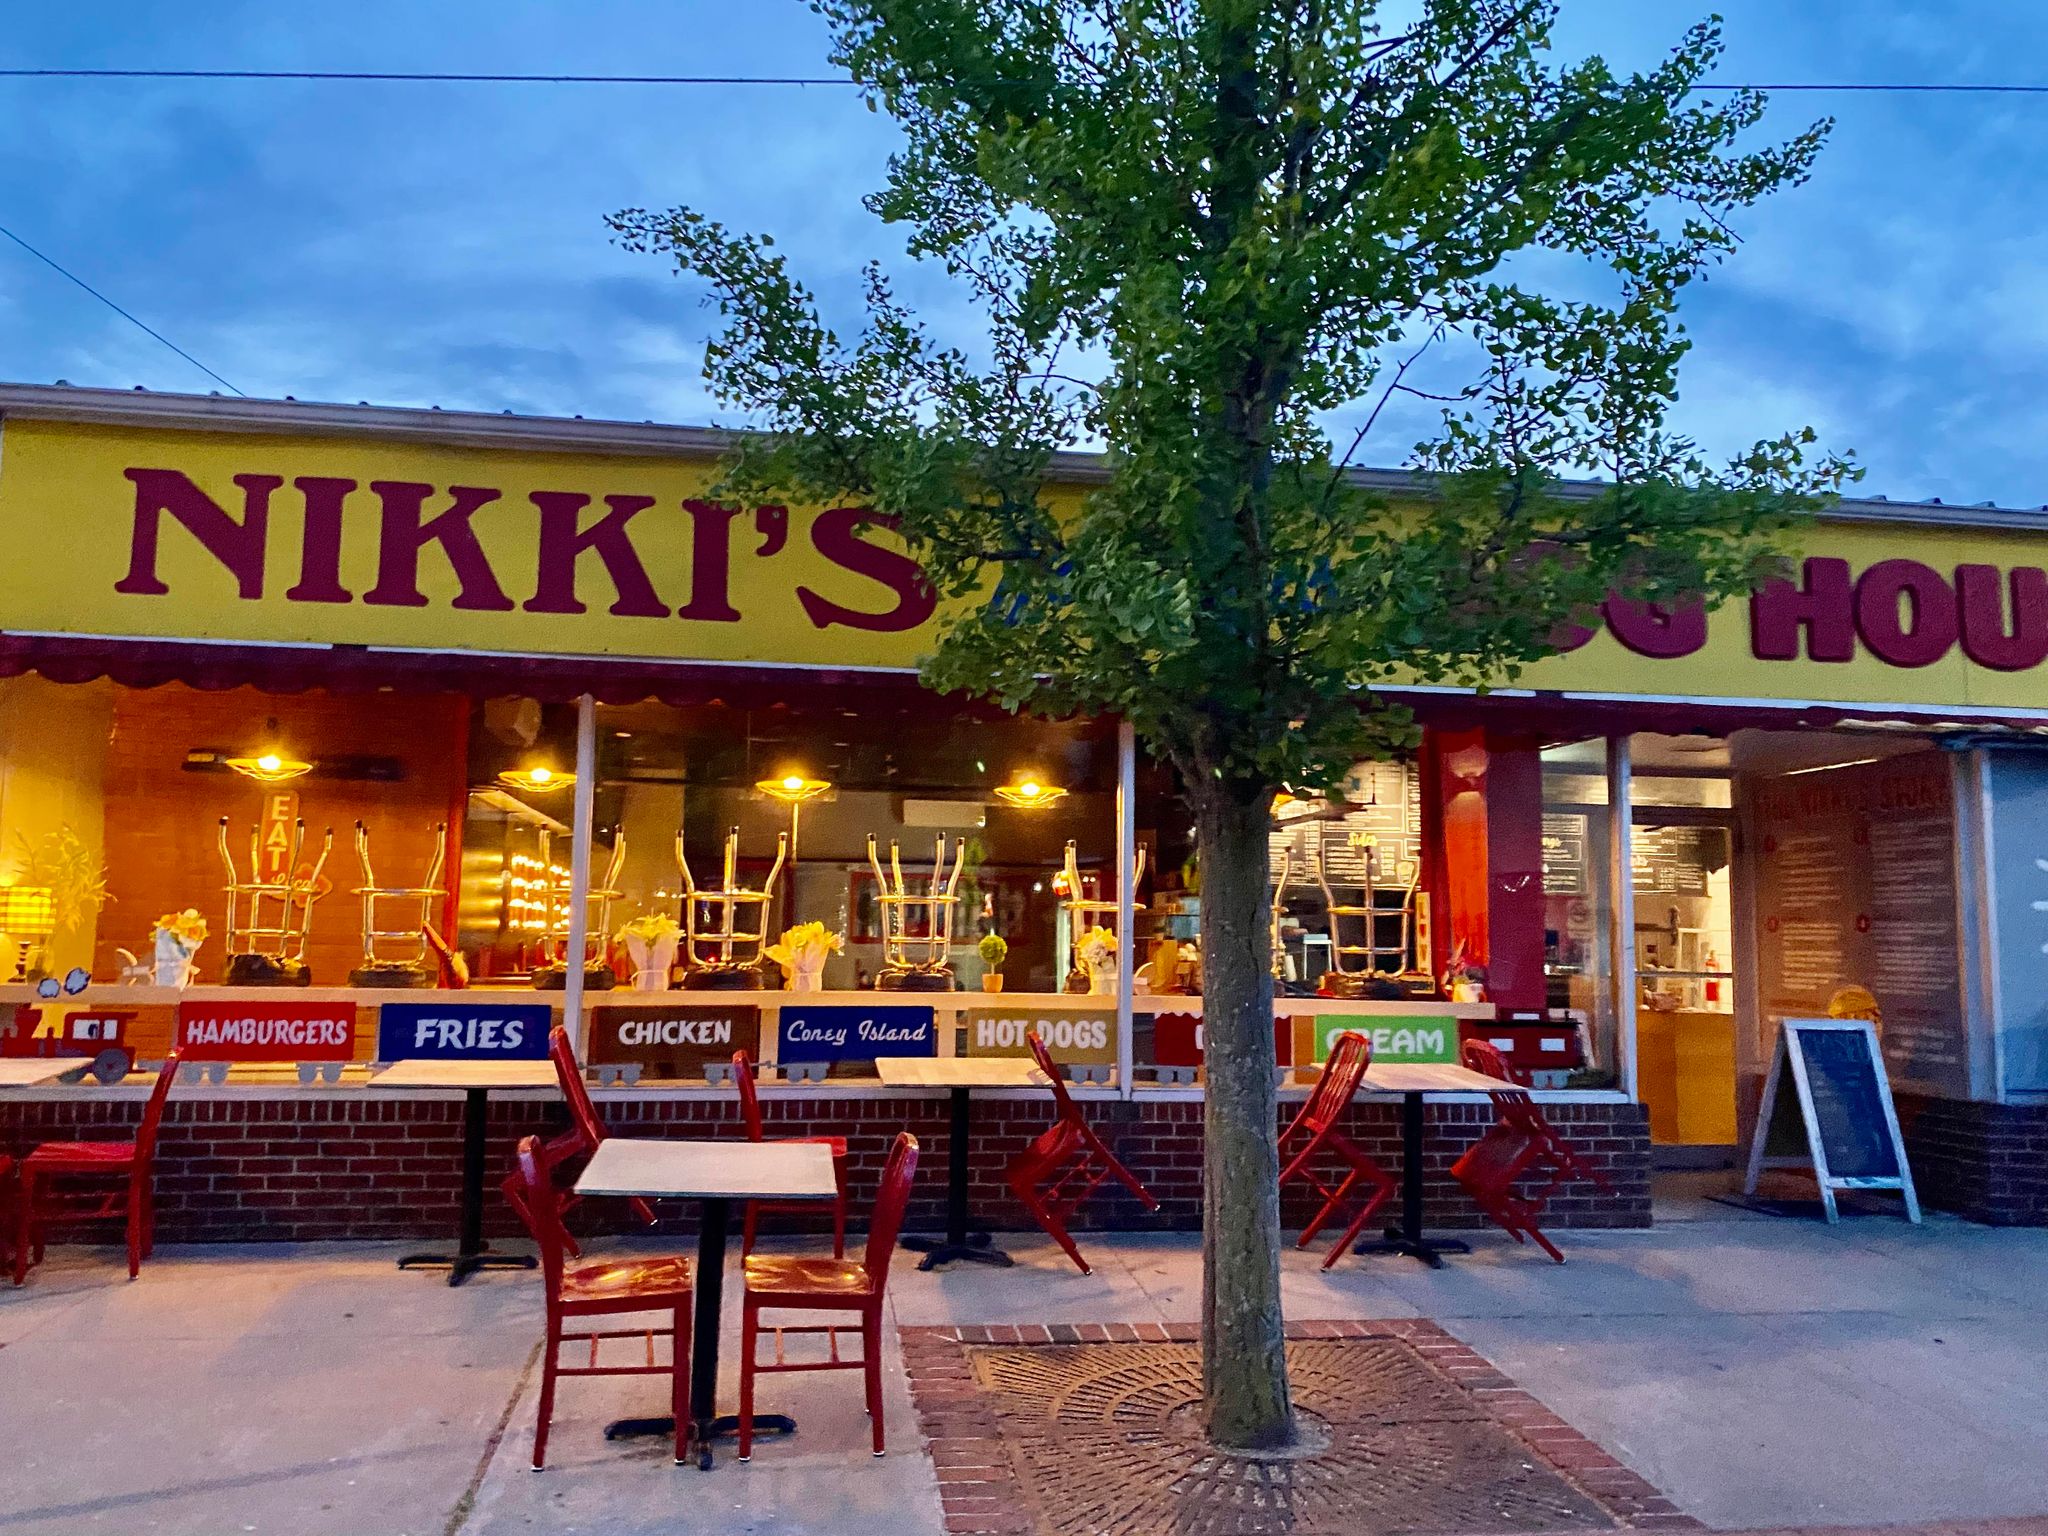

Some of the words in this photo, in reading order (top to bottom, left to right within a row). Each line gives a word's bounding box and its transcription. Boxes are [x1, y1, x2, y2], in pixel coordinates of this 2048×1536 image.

[113, 466, 938, 633] NIKKI'S
[1750, 555, 2048, 672] HOU
[266, 795, 291, 872] EAT
[186, 1017, 347, 1046] HAMBURGERS
[414, 1018, 524, 1049] FRIES
[618, 1019, 732, 1046] CHICKEN
[786, 1020, 848, 1046] Coney
[857, 1019, 927, 1043] Island
[976, 1019, 1029, 1048] HOT
[1035, 1020, 1107, 1049] DOGS
